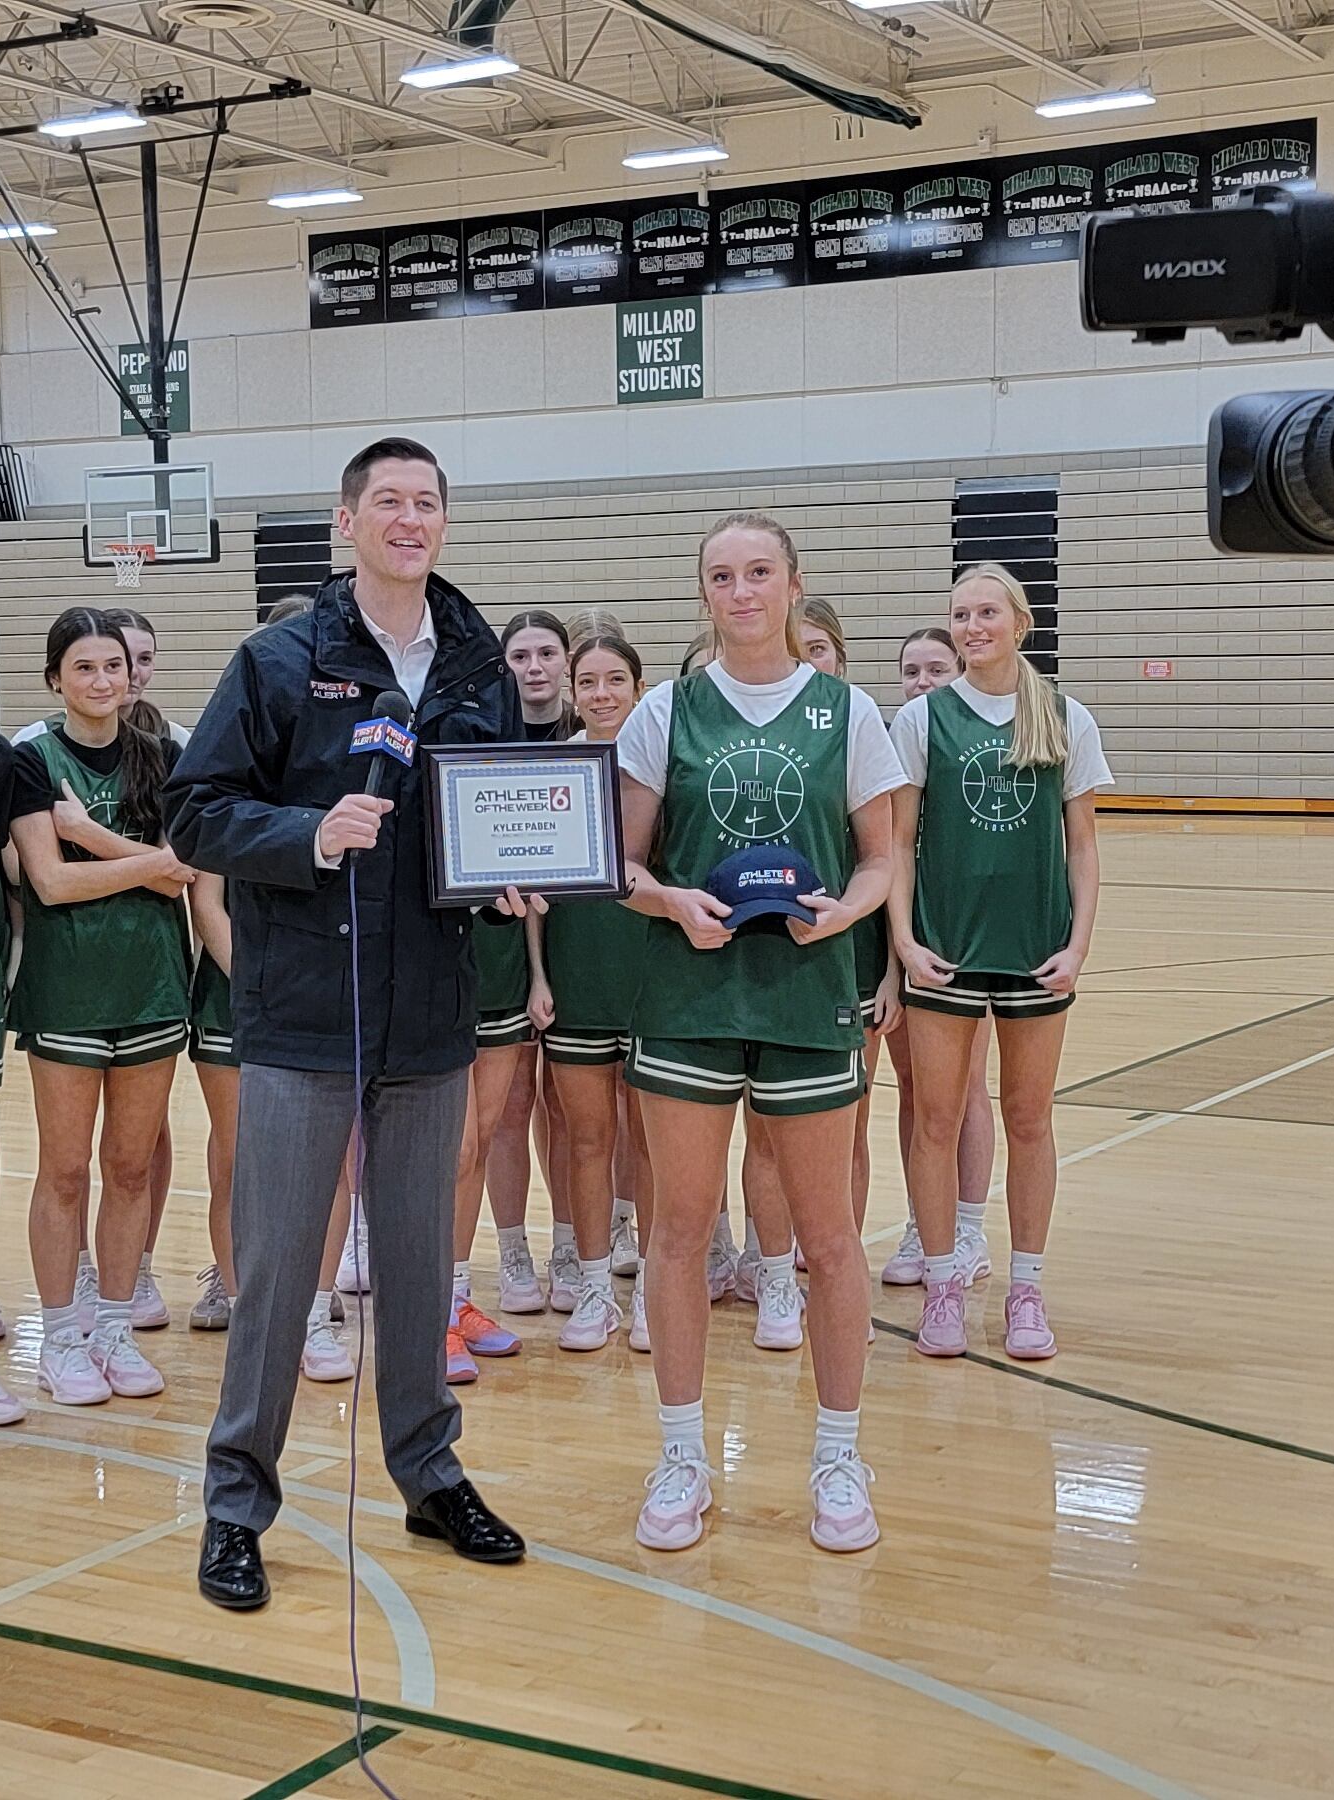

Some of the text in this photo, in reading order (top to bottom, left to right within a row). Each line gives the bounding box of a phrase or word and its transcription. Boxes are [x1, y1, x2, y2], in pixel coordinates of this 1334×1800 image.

[1211, 138, 1311, 175] MILLARD WEST
[1104, 152, 1199, 187] MILLARD WEST
[1242, 169, 1279, 185] NSAA
[1003, 165, 1093, 199] MILLARD WEST
[1134, 182, 1170, 198] NSAA
[904, 177, 991, 210] MILLARD WEST
[810, 189, 893, 222] MILLARD WEST
[1031, 195, 1065, 209] NSAA
[931, 206, 964, 220] NSAA
[836, 217, 867, 231] NSAA
[745, 226, 775, 240] NSAA
[657, 235, 686, 248] NSAA
[623, 308, 696, 338] MILLARD
[637, 337, 683, 364] WEST
[121, 352, 145, 376] PEP
[619, 364, 702, 393] STUDENTS
[310, 680, 343, 691] FIRST
[347, 681, 360, 698] 6
[313, 690, 344, 699] ALERT
[805, 706, 833, 730] 42
[354, 727, 375, 738] FIRST
[373, 724, 382, 743] 6
[386, 725, 406, 744] FIRST
[353, 736, 373, 746] ALERT
[385, 736, 405, 752] ALERT
[405, 740, 413, 758] 6
[705, 738, 810, 770] MILLARD WEST
[958, 738, 1005, 763] MILLARD
[475, 789, 548, 802] ATHLETE
[552, 787, 569, 810] 6
[475, 802, 548, 813] OF THE WEEK
[493, 823, 523, 832] KYLEE
[970, 816, 1027, 832] WILDCATS
[718, 833, 790, 850] WILDTS
[499, 845, 554, 857] WOODHOUSE
[738, 869, 784, 880] ATHLETE
[786, 869, 795, 884] 6
